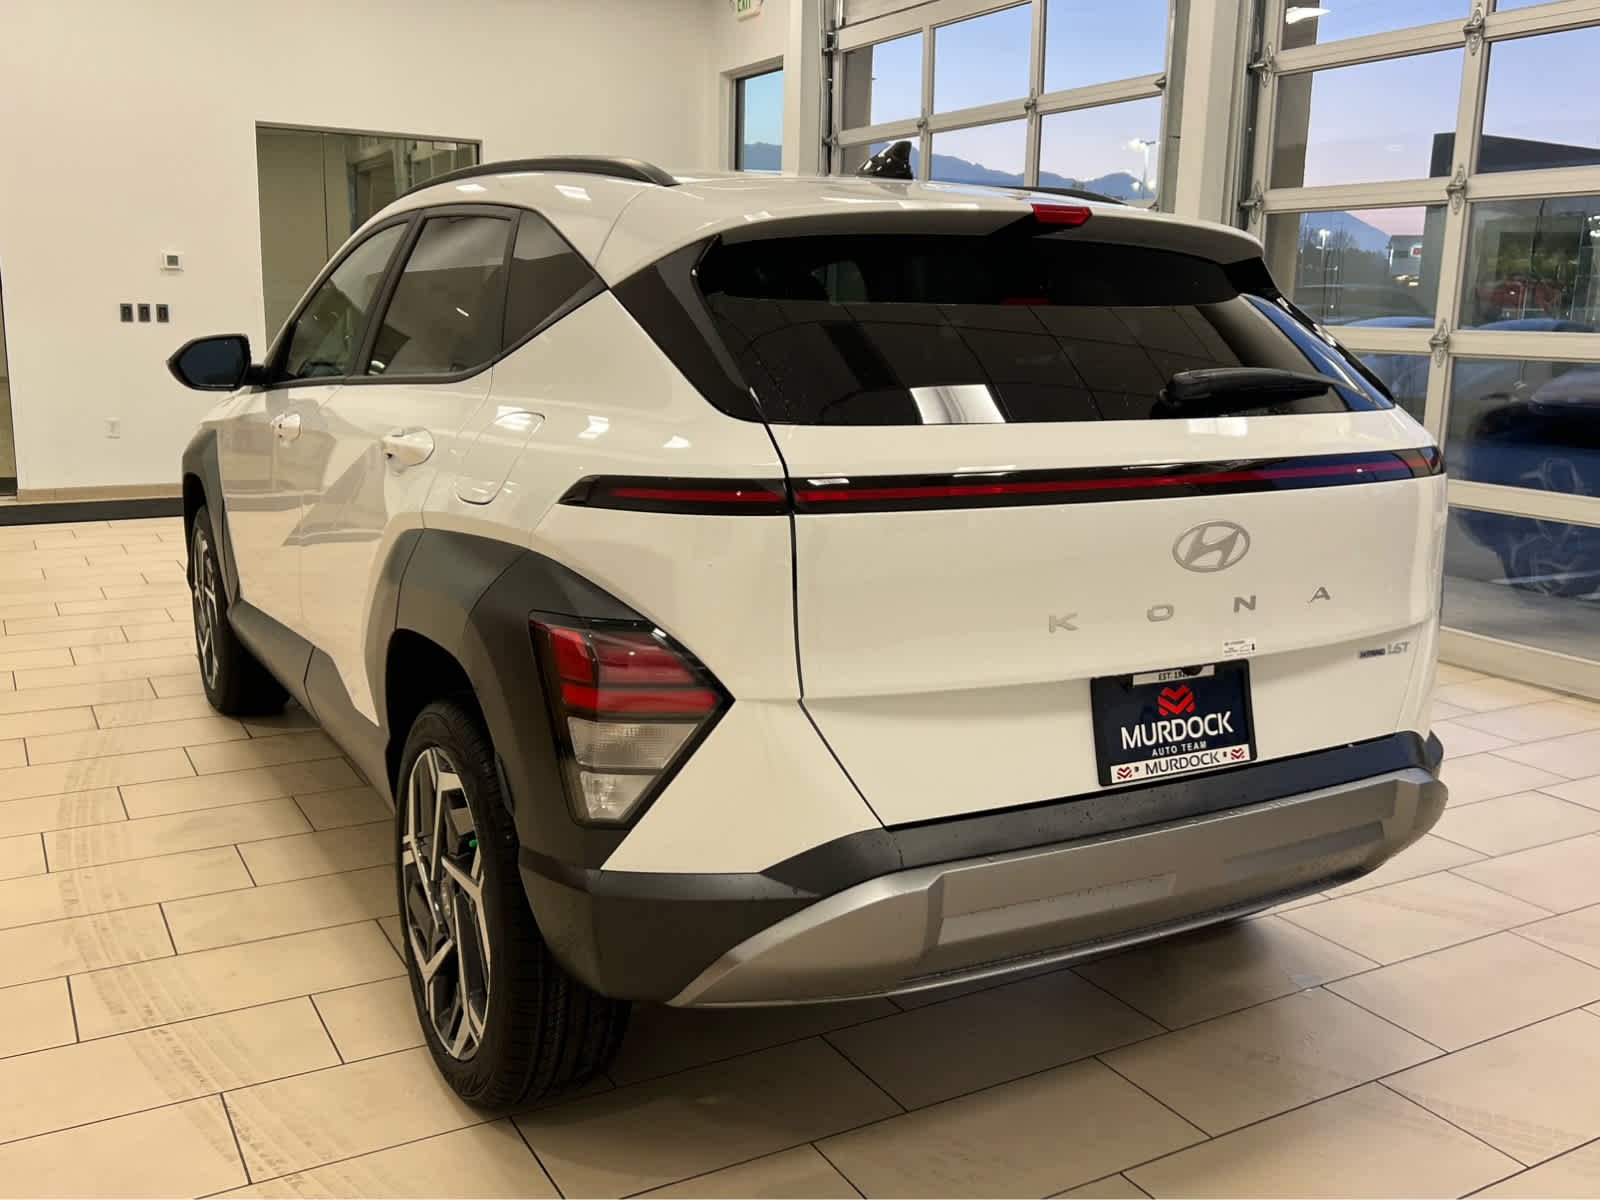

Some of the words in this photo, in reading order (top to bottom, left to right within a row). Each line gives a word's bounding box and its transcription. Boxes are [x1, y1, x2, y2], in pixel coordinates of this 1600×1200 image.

[1048, 587, 1331, 633] KONA
[1121, 711, 1233, 750] MURDOCK
[1151, 745, 1178, 757] AUTO
[1181, 740, 1207, 752] TEAM
[1145, 753, 1220, 775] MURDOCK
